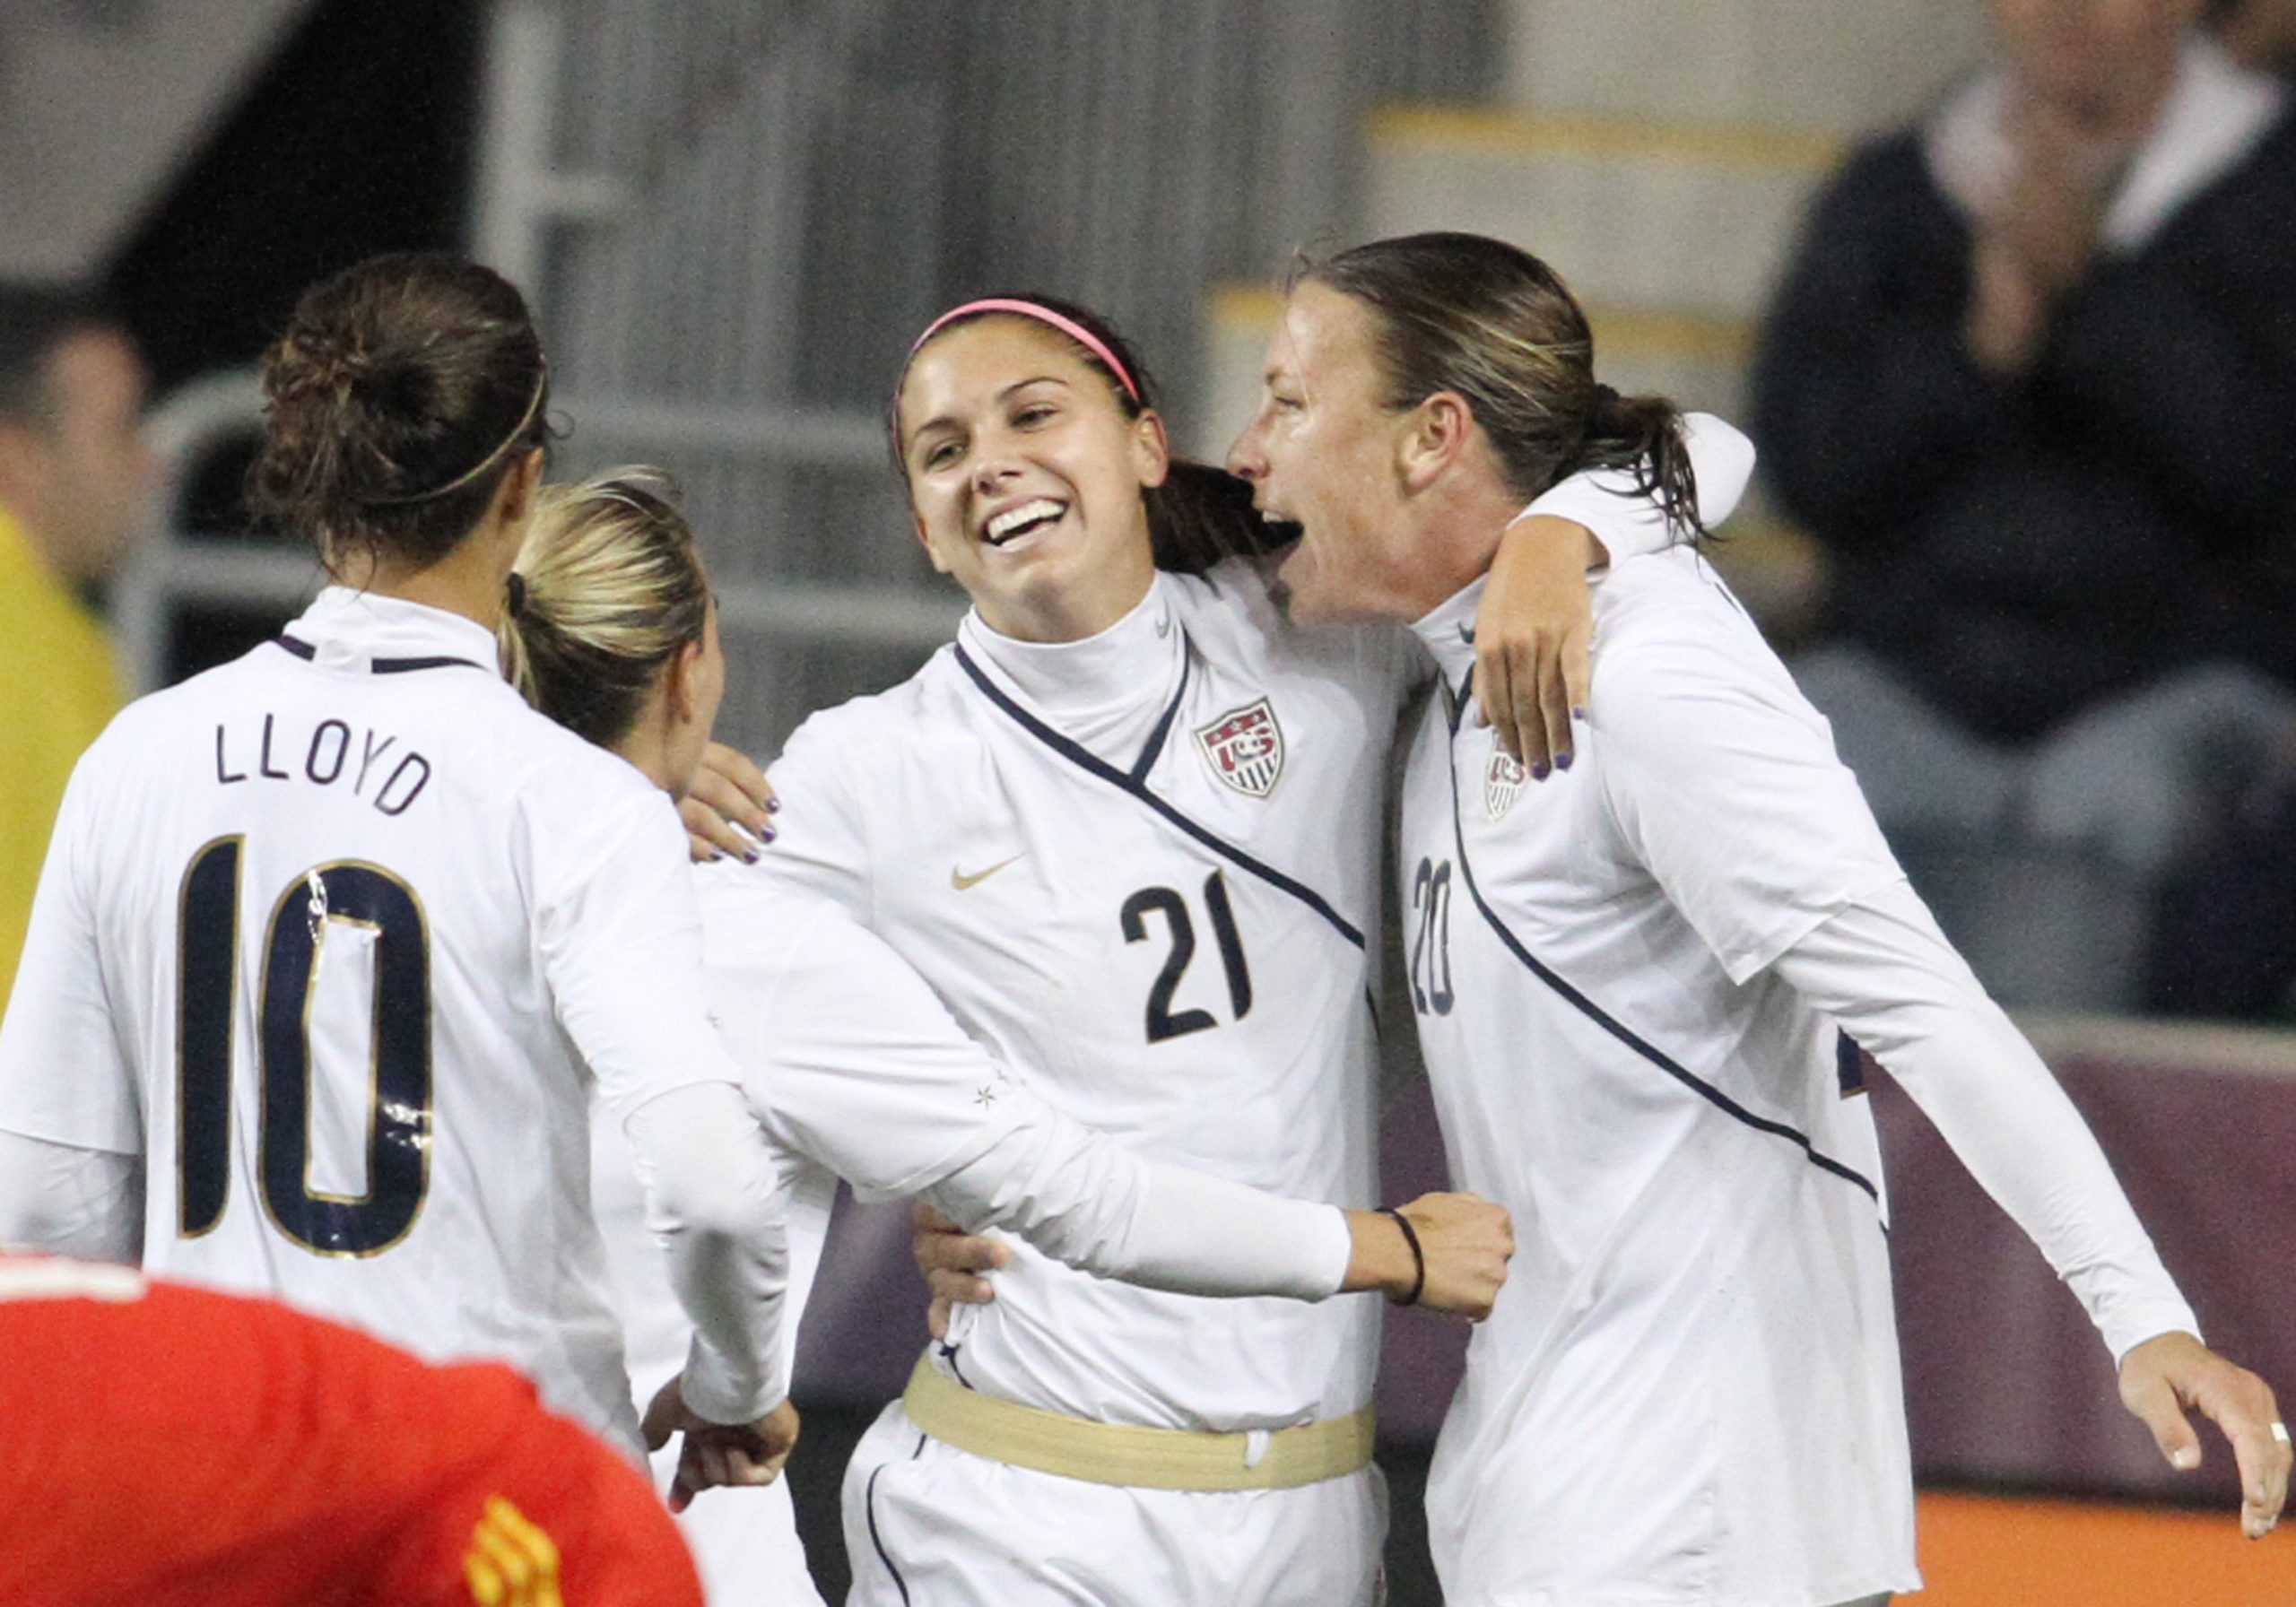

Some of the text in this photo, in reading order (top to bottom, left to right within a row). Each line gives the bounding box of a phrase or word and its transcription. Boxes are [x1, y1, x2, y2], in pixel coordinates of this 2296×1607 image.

[216, 714, 430, 815] LLOYD
[1120, 868, 1252, 1044] 21
[1412, 856, 1455, 1016] 20
[177, 833, 431, 1257] 10
